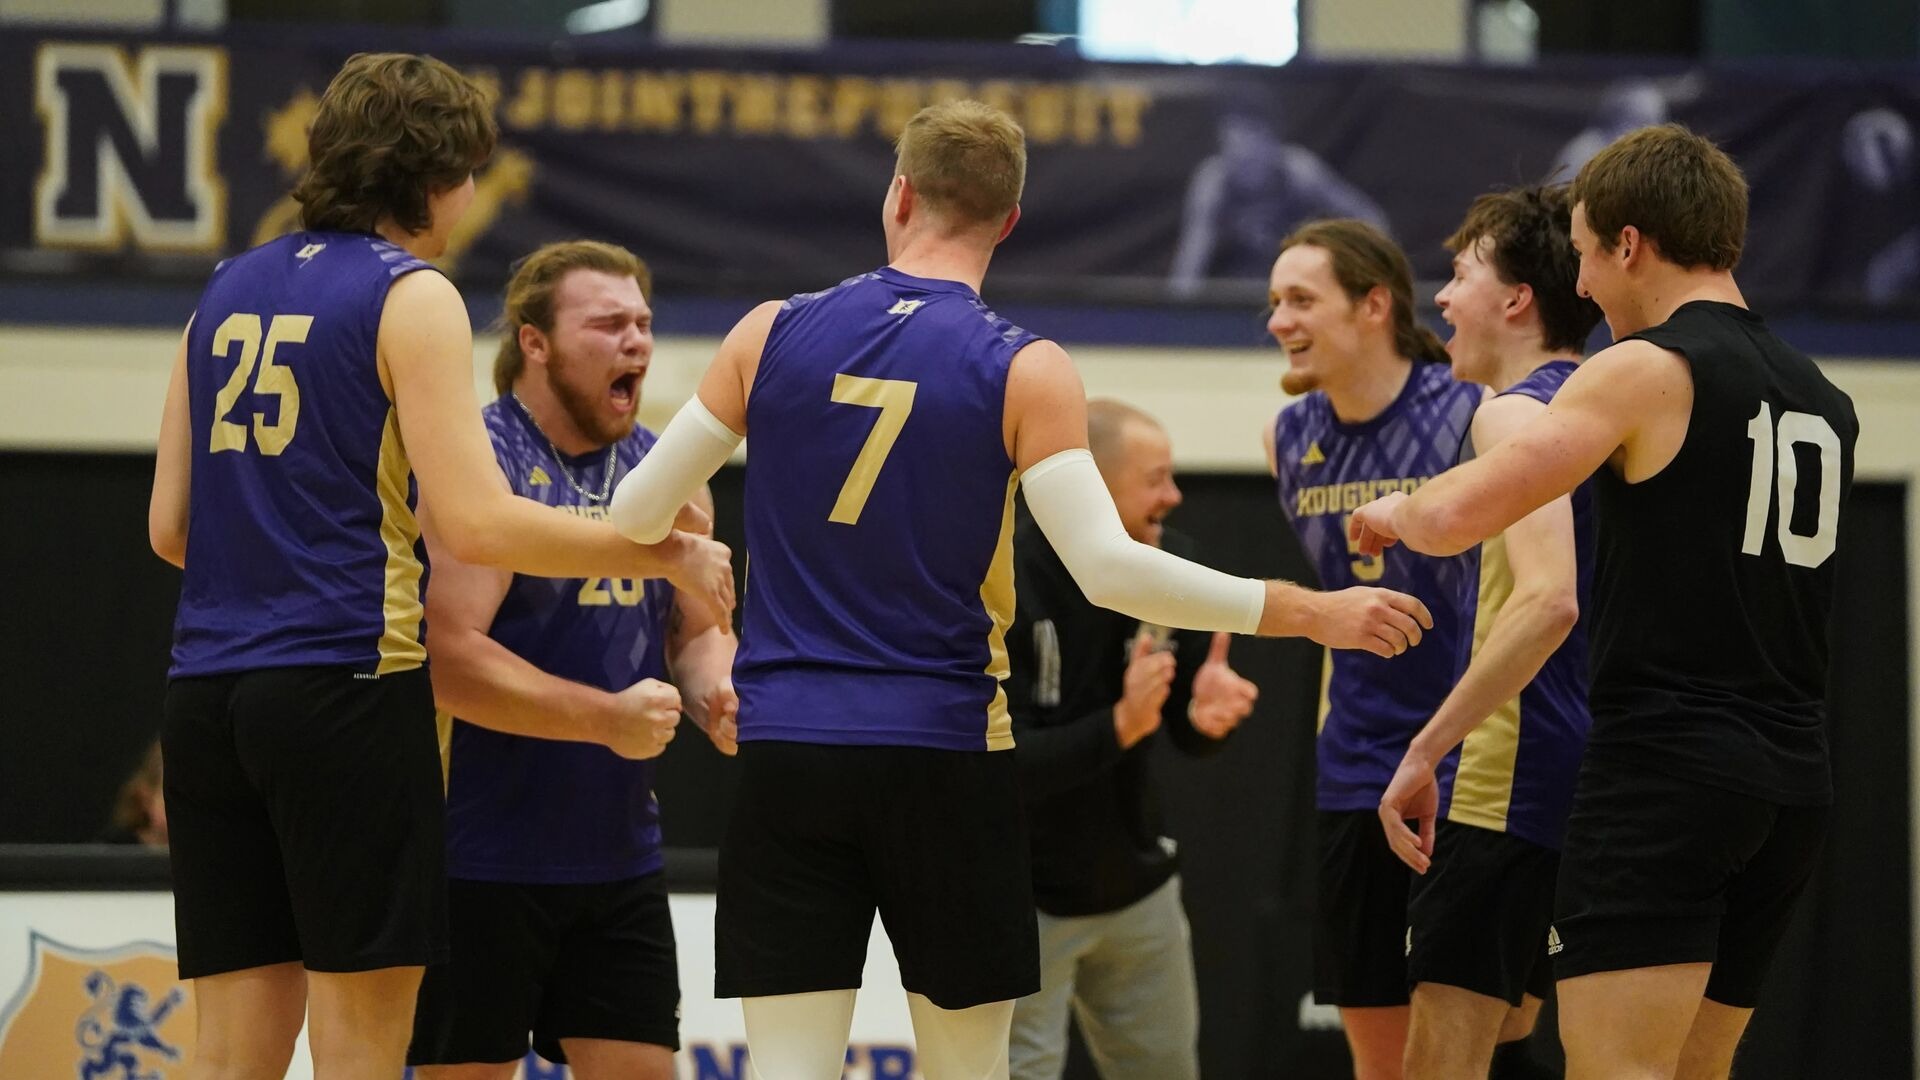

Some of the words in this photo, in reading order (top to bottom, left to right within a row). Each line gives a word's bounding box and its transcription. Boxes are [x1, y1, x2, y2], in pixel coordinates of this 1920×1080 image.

[35, 43, 229, 254] N
[210, 312, 315, 456] 25
[827, 373, 918, 525] 7
[1296, 476, 1431, 517] HOUGHTO
[1741, 400, 1842, 569] 10
